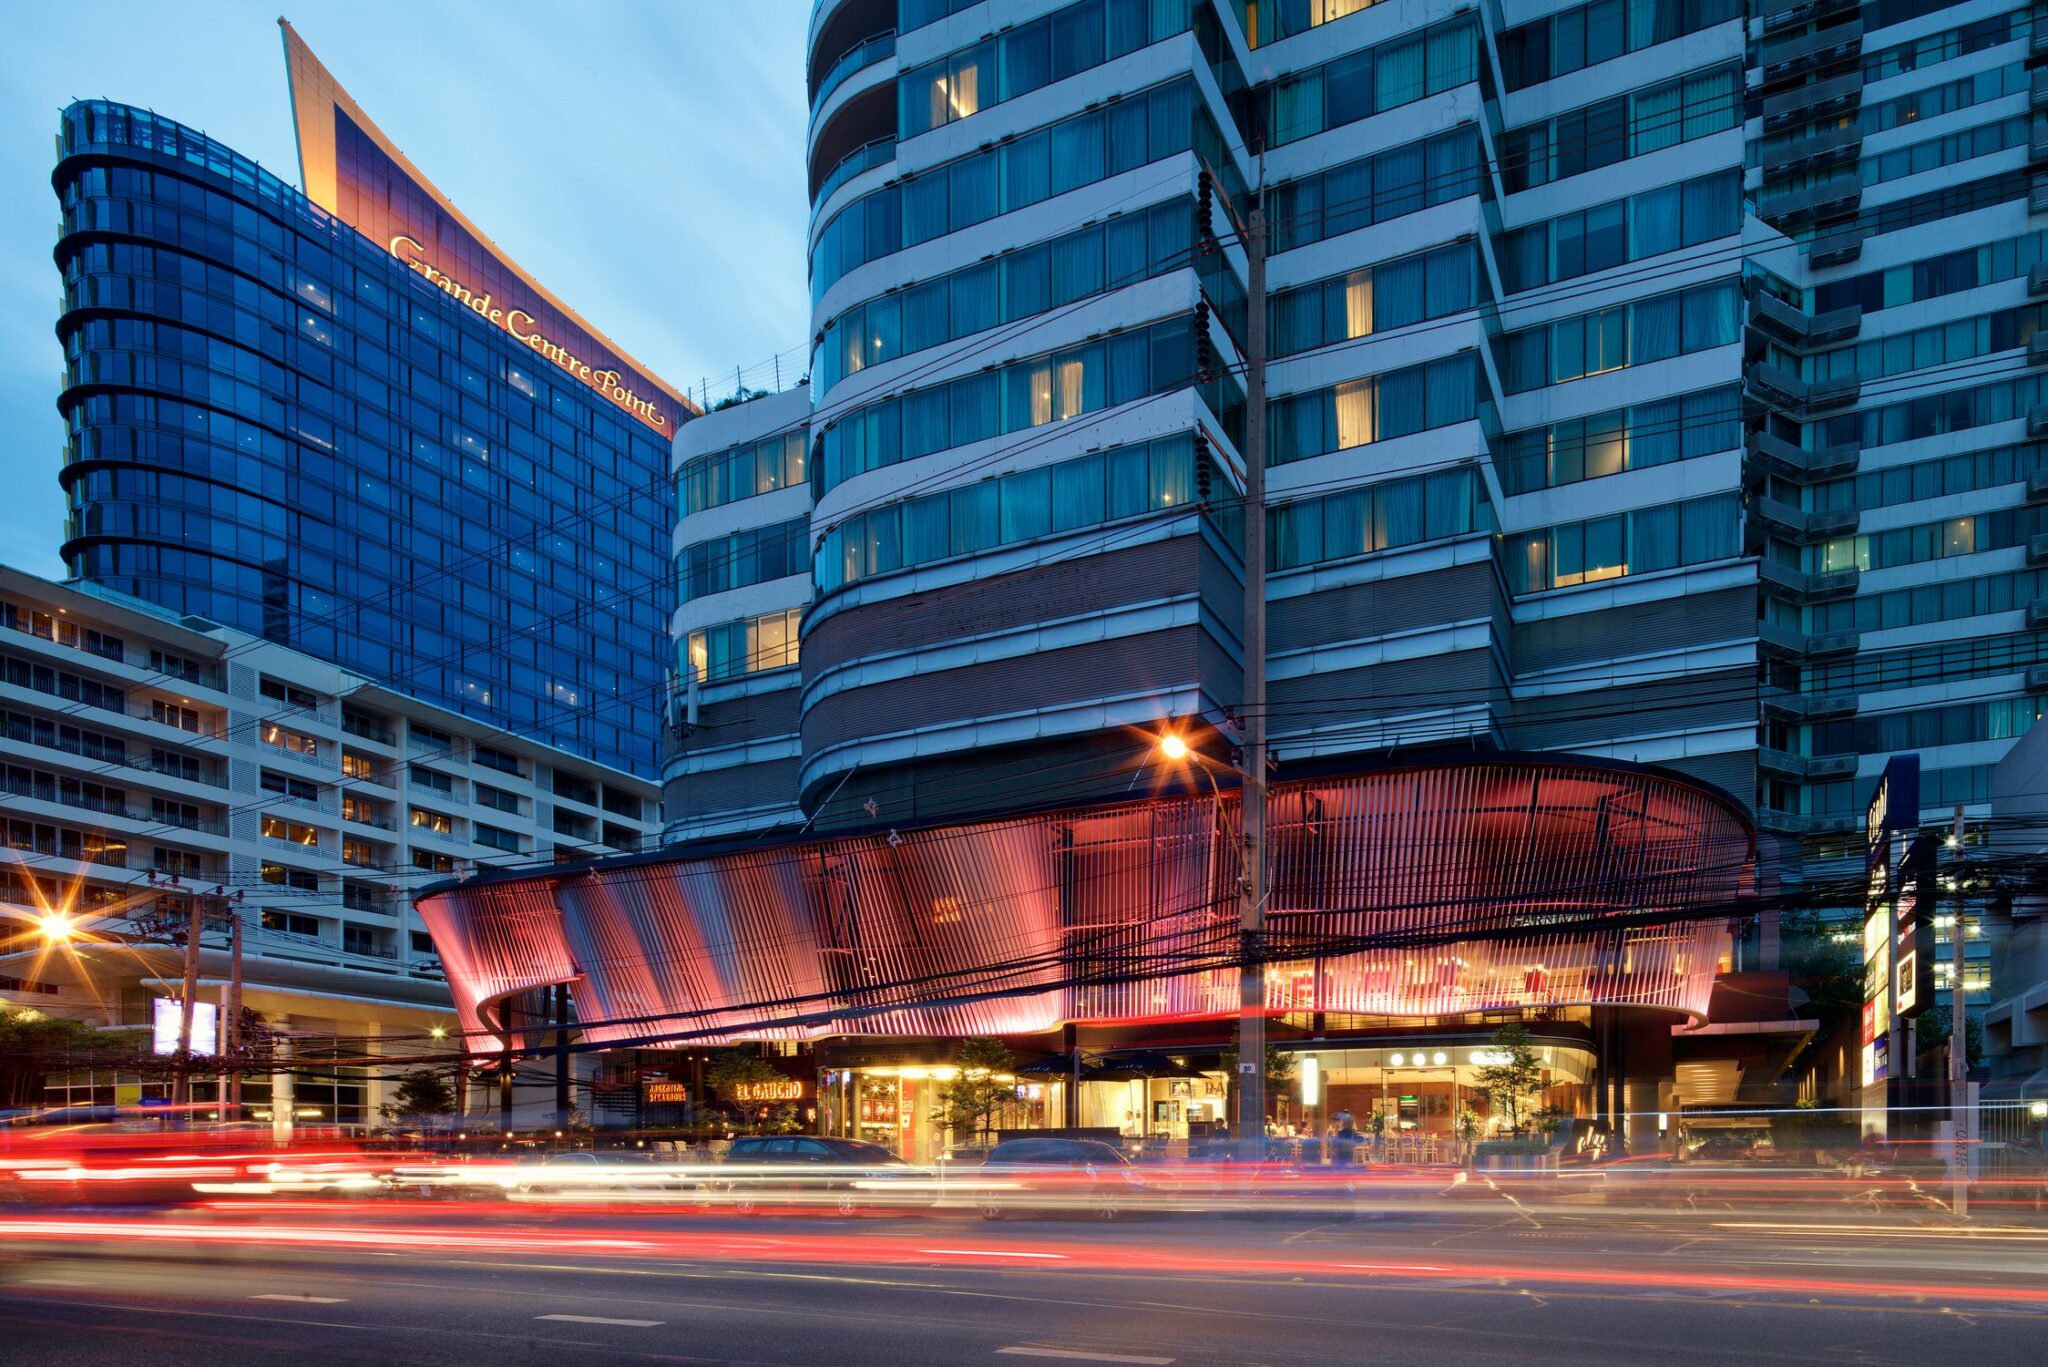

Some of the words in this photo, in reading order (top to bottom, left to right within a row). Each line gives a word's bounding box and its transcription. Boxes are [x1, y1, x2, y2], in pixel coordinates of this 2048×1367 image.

[389, 235, 502, 324] Grande
[506, 309, 591, 380] Centre
[593, 369, 665, 426] Point
[736, 1083, 750, 1100] EL
[752, 1081, 802, 1100] GAUCHO
